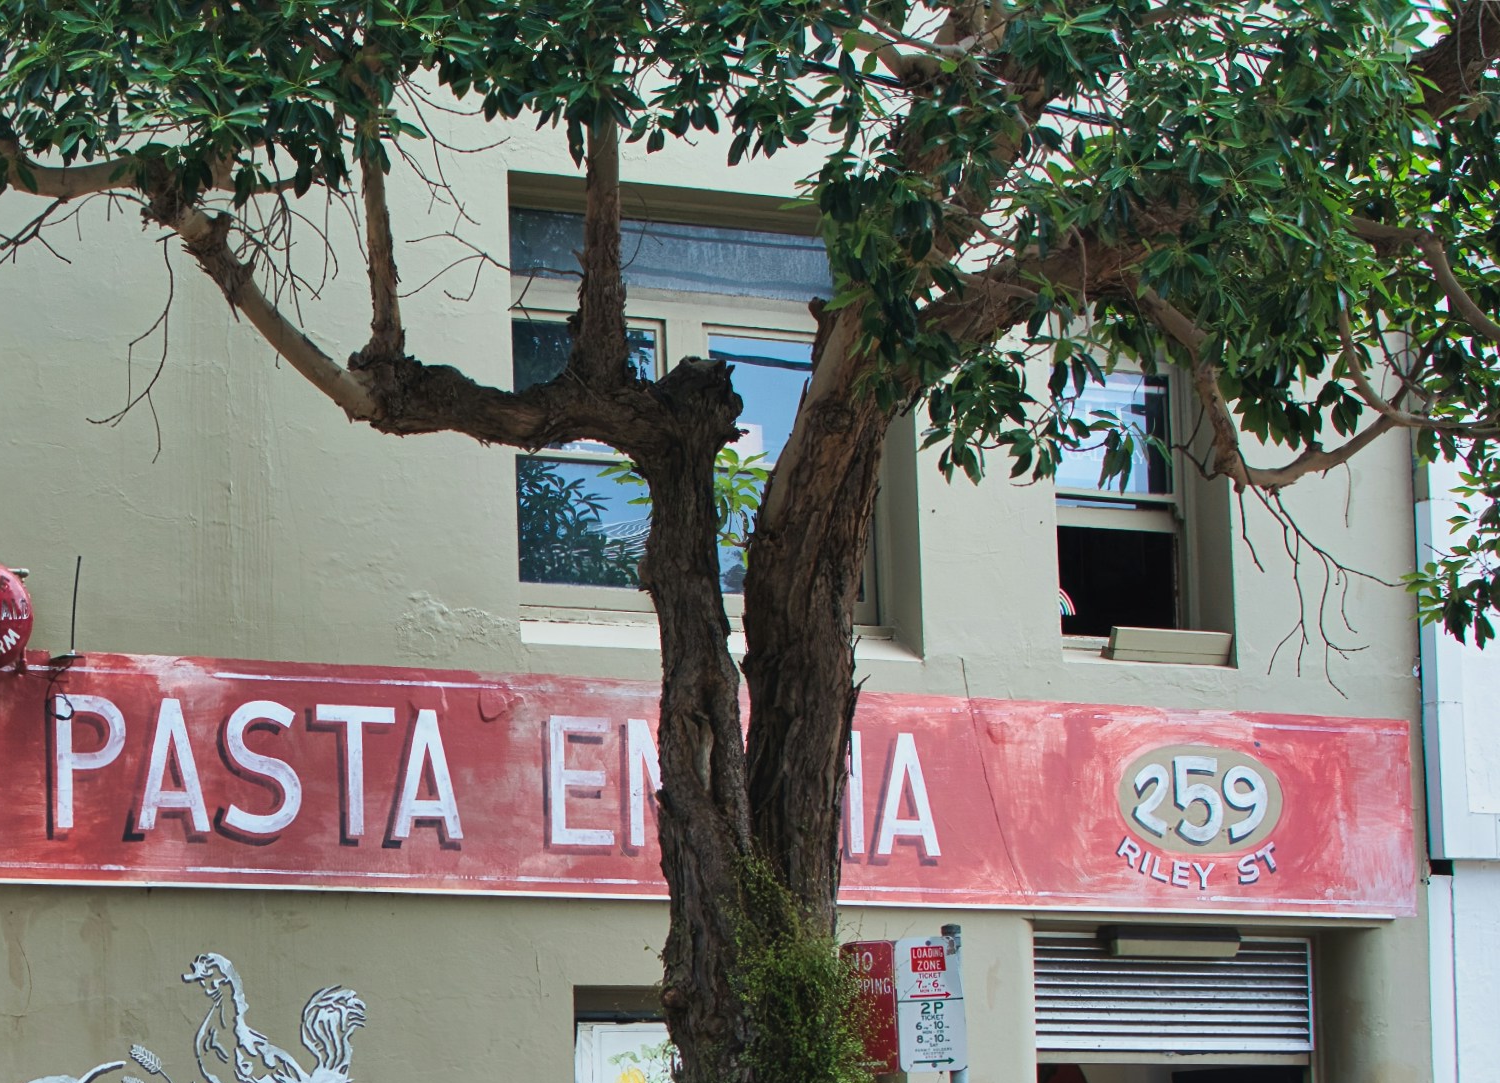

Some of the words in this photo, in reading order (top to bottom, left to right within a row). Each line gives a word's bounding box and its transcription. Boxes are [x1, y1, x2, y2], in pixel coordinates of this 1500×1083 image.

[53, 694, 463, 844] PASTA
[1133, 755, 1268, 845] 259
[1117, 836, 1216, 889] RILEY
[1237, 841, 1277, 884] ST
[912, 948, 944, 959] LOADING
[917, 960, 942, 971] ZONE
